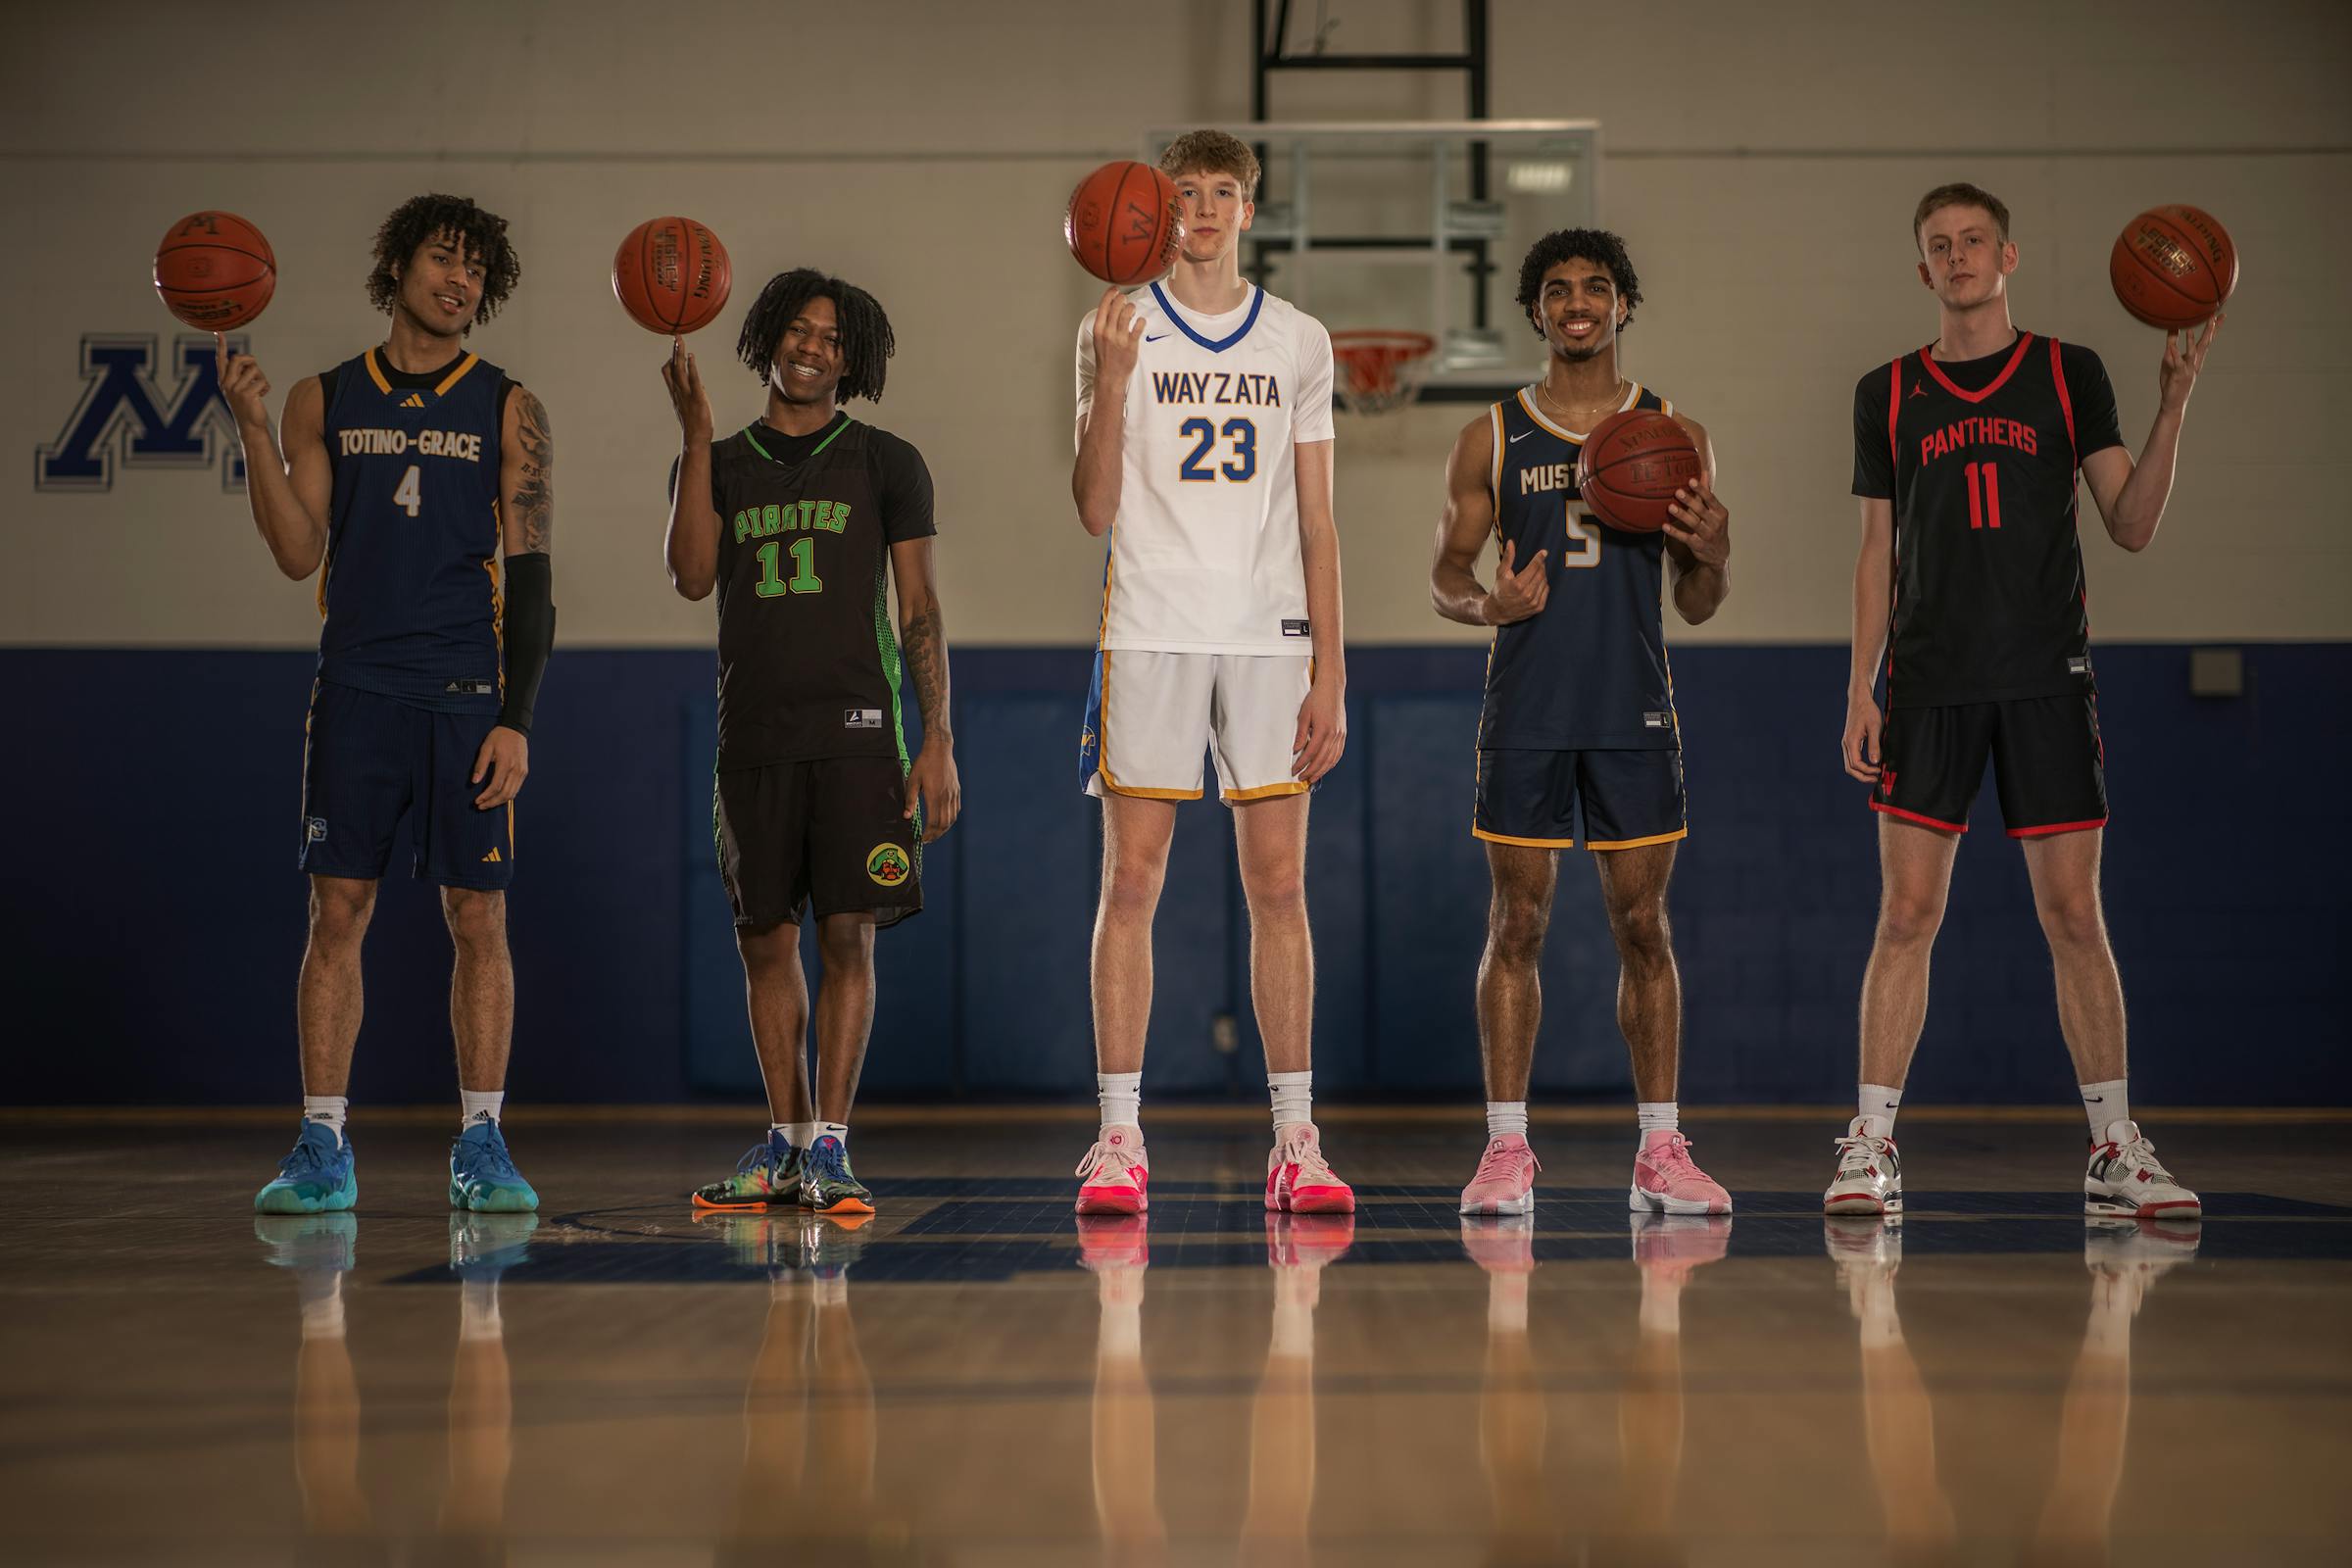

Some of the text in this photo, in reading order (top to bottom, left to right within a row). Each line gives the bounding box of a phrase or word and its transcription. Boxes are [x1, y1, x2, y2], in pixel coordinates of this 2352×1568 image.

[1152, 372, 1281, 408] WAYZATA
[339, 428, 481, 463] TOTINO-GRACE
[1179, 416, 1257, 483] 23
[1921, 416, 2037, 466] PANTHERS
[393, 465, 421, 517] 4
[1520, 464, 1581, 495] MUST
[1964, 462, 2001, 529] 11
[734, 500, 852, 544] PIRATES
[1565, 499, 1601, 567] 5
[756, 537, 822, 599] 11
